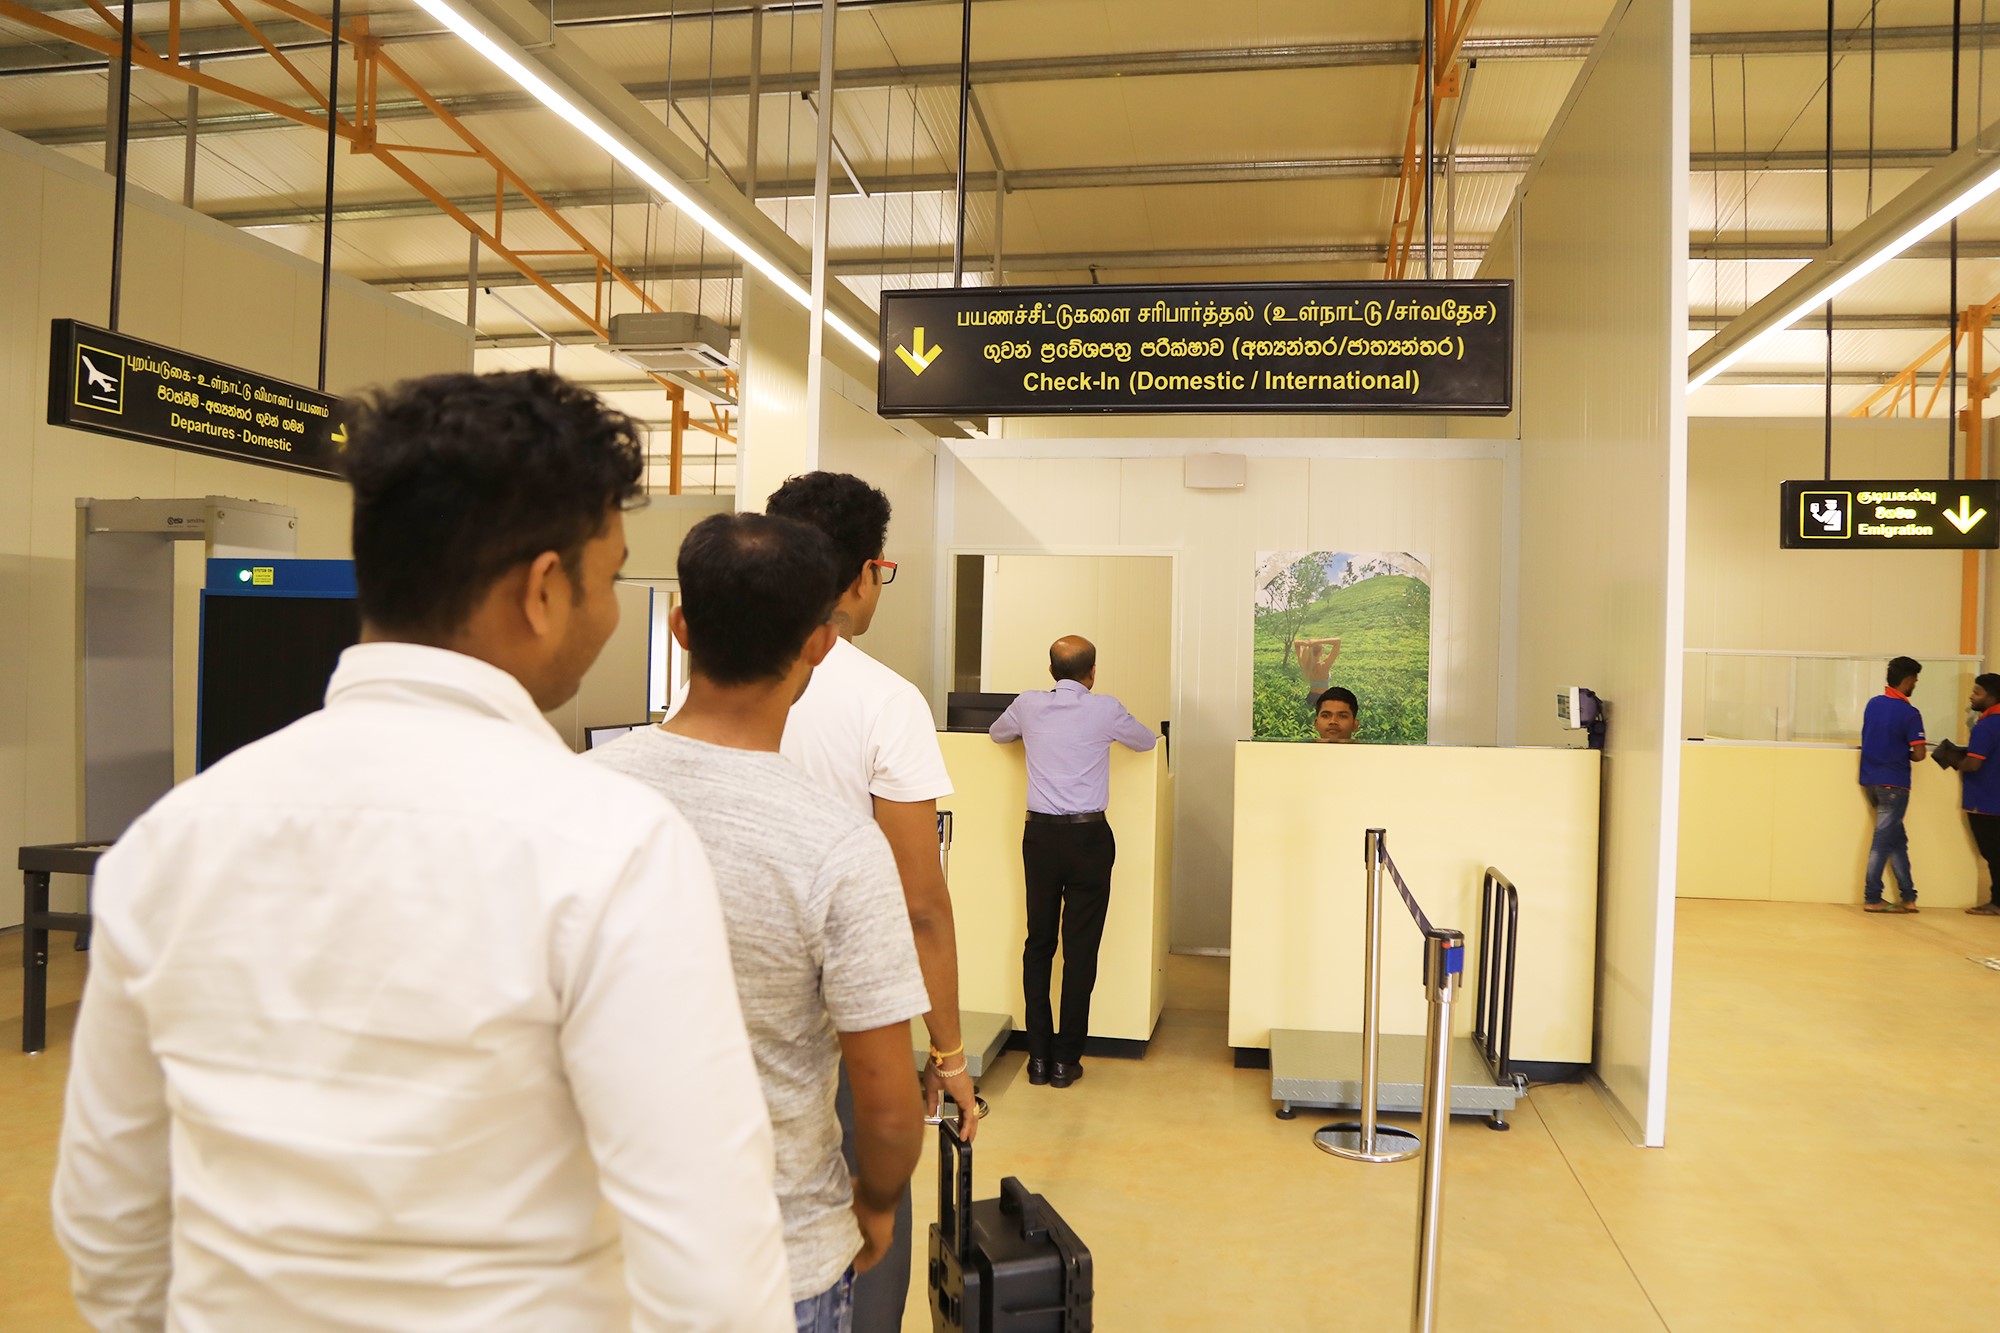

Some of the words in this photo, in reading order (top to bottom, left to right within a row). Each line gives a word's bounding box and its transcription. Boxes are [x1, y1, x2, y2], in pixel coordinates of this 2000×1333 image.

[957, 302, 1131, 330] பயணச்சீட்டுகளை
[1137, 301, 1254, 328] சரிபார்த்தல்
[983, 340, 1032, 364] ගුවන්
[1023, 371, 1120, 392] Check-In
[1129, 371, 1245, 395] (Domestic
[1265, 369, 1420, 394] International)
[296, 400, 329, 418] பயணம்
[171, 412, 235, 440] Departures
[243, 429, 292, 452] Domestic
[1858, 523, 1933, 538] Emigration
